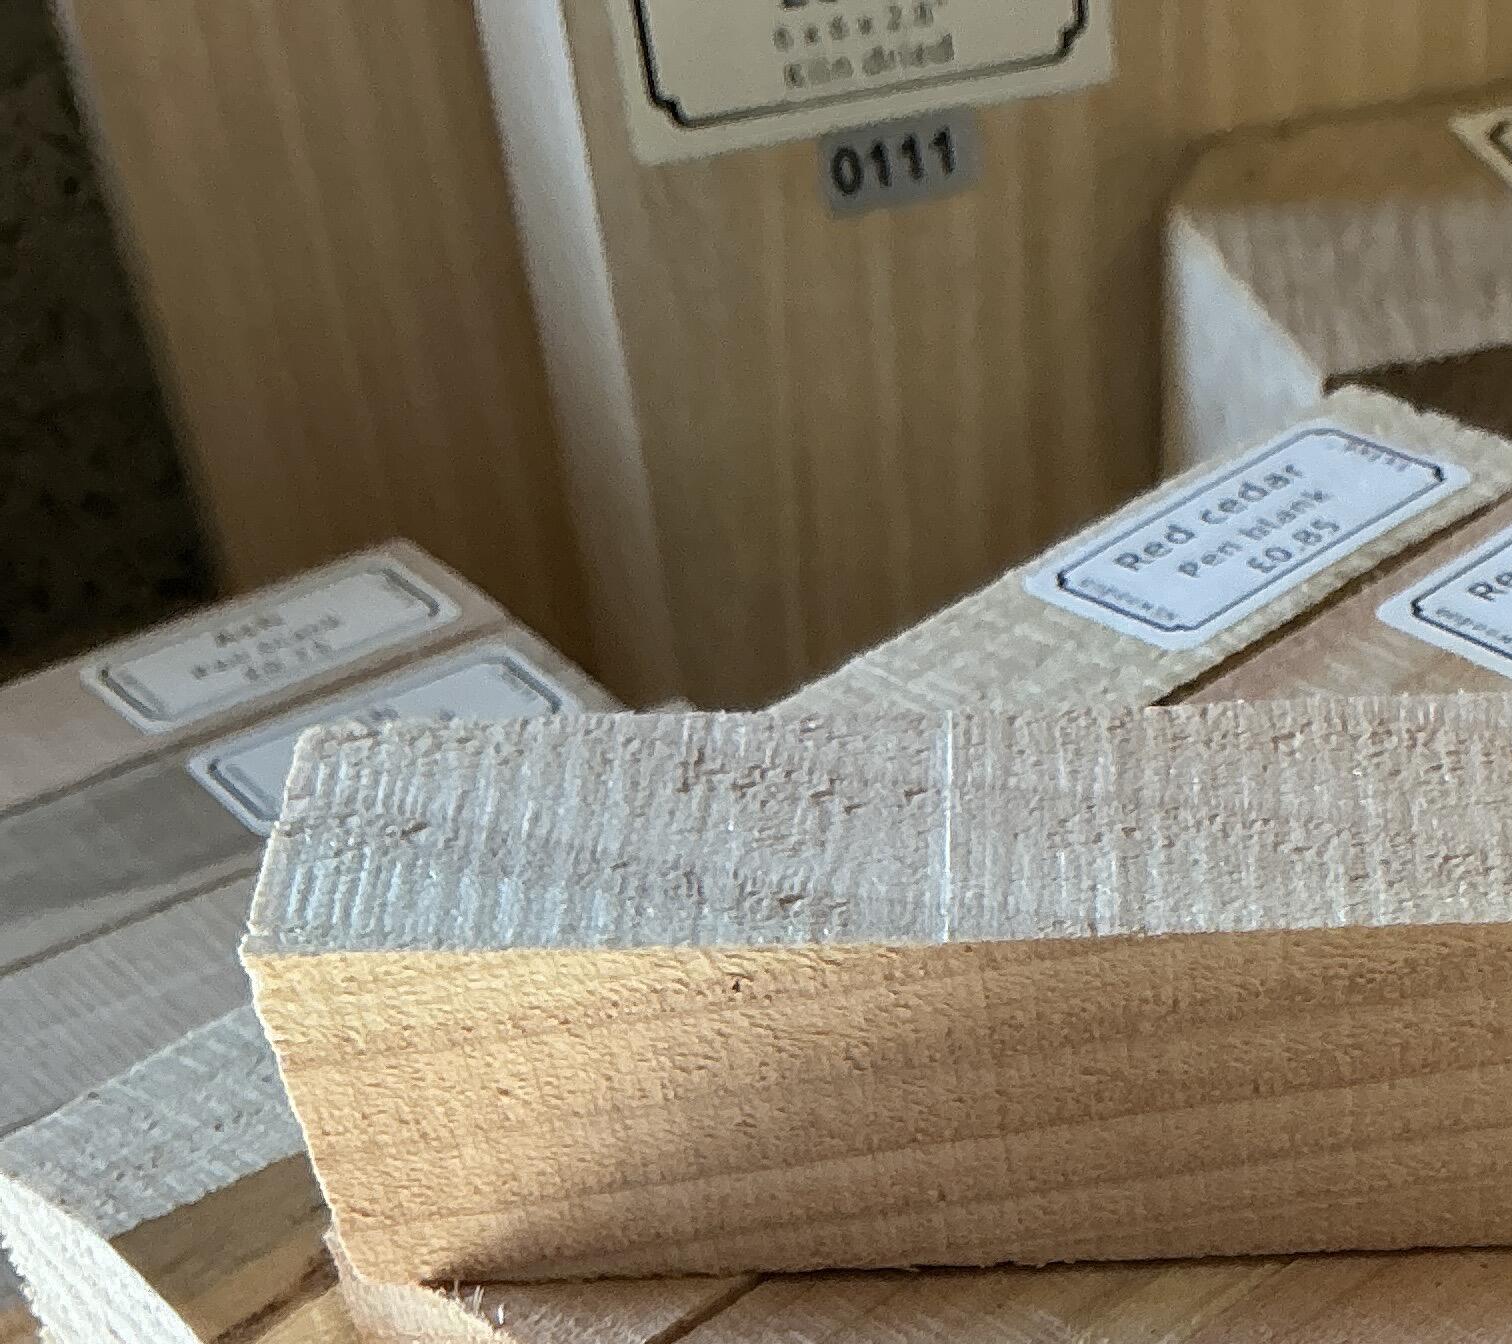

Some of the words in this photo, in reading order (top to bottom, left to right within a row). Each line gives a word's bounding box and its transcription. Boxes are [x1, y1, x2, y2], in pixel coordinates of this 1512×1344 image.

[830, 126, 956, 196] 0111
[1113, 523, 1196, 572] Red
[1200, 463, 1303, 525] cedar
[1177, 541, 1243, 578] Pen
[1239, 489, 1329, 541] blank
[1247, 518, 1341, 574] £0.85
